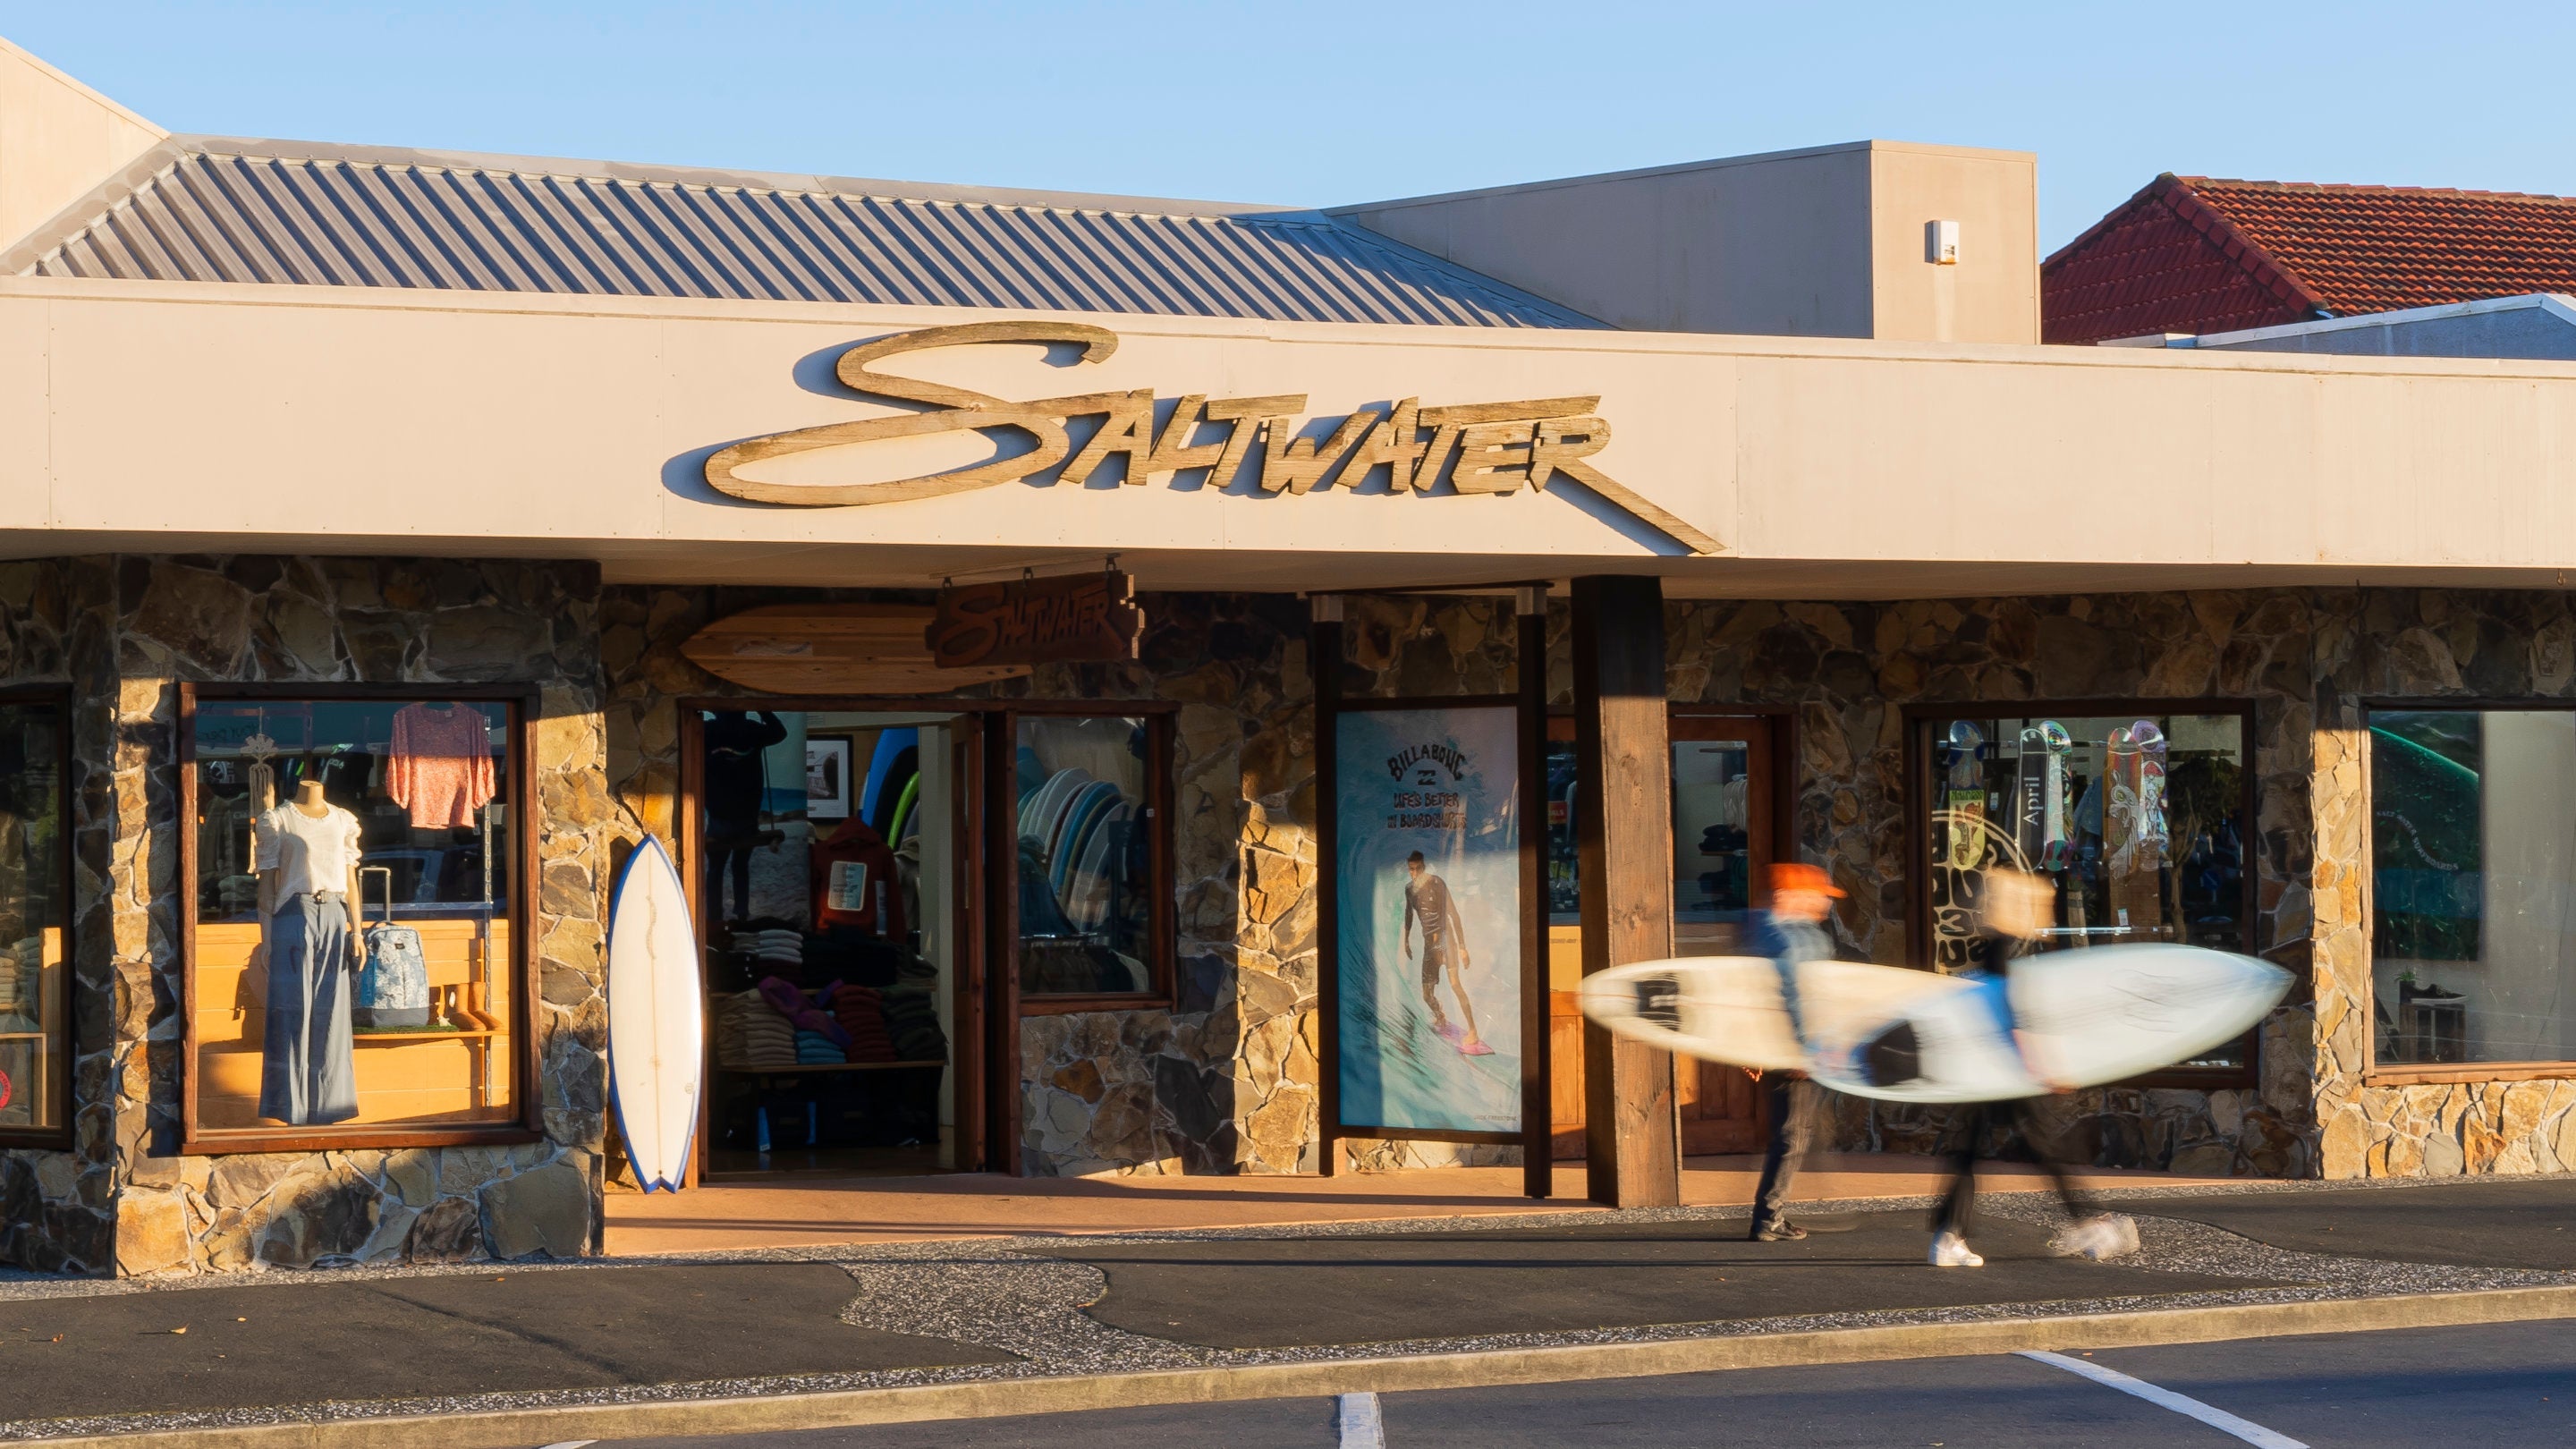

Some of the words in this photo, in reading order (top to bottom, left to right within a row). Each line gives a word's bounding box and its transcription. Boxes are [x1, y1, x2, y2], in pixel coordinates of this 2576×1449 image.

[705, 321, 1727, 554] SALTWATER
[936, 580, 1125, 667] SALTWATER
[1387, 744, 1468, 782] BILLABONG
[1394, 792, 1421, 809] LIFE'S
[1425, 792, 1459, 808] BETTER
[2022, 776, 2044, 826] April
